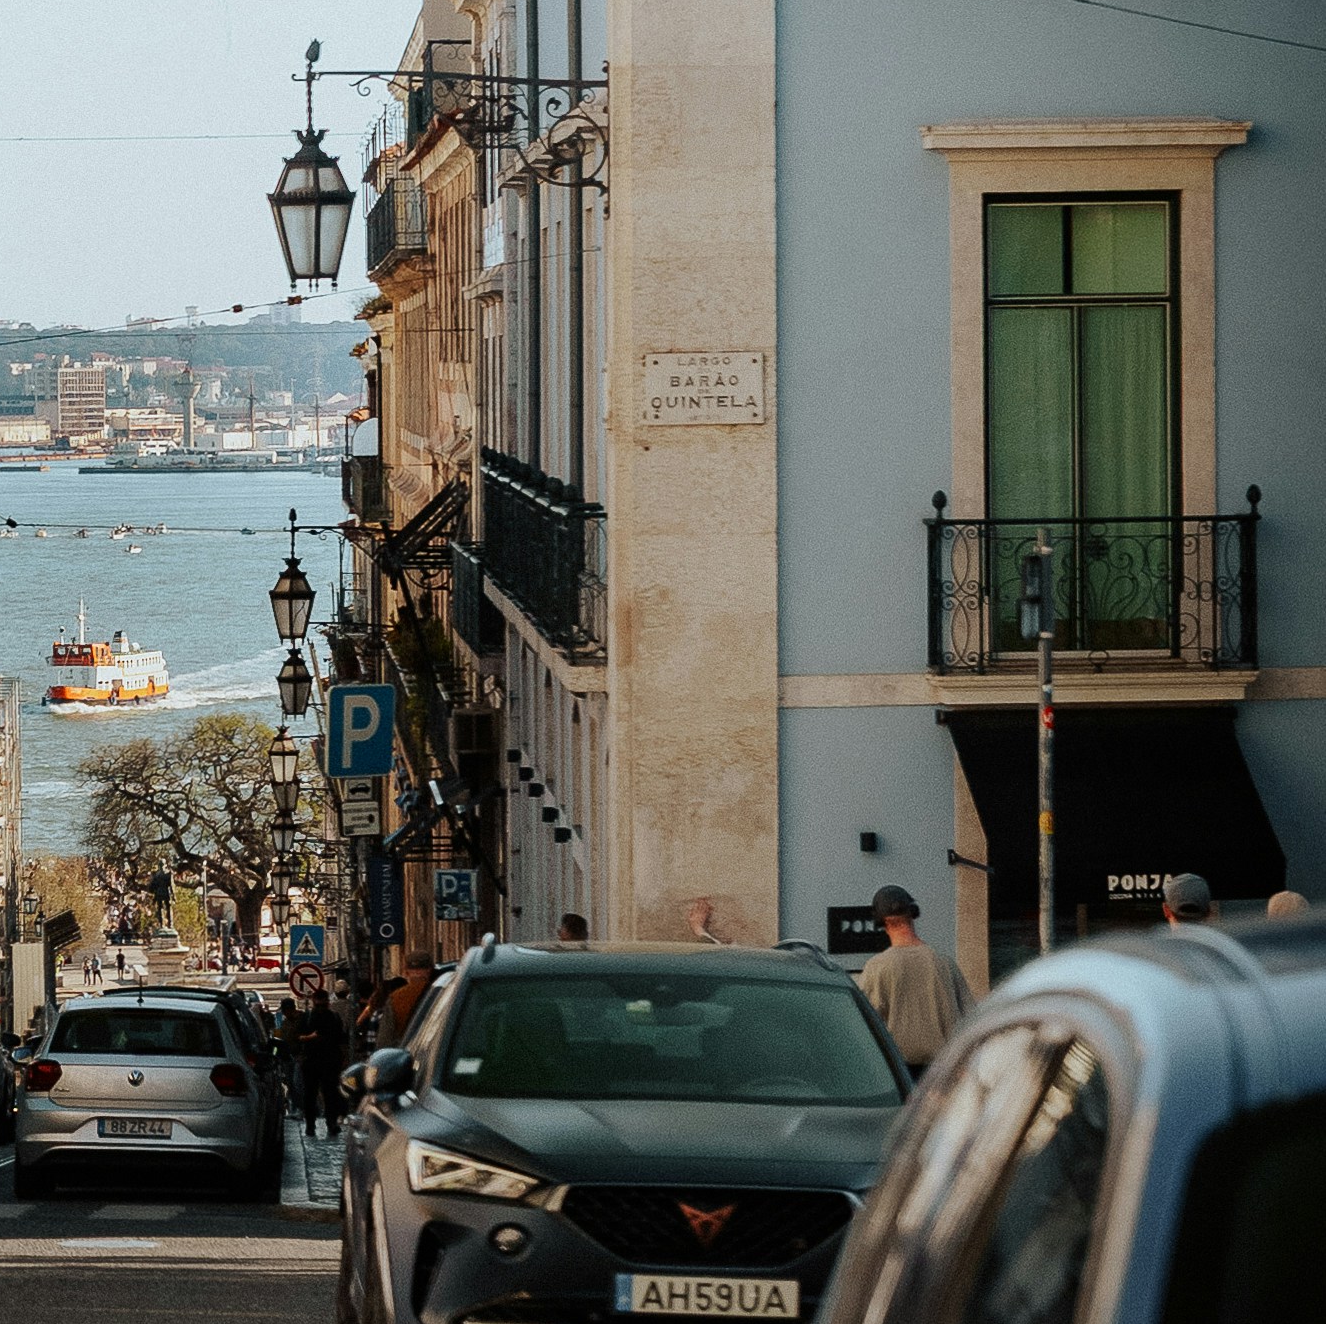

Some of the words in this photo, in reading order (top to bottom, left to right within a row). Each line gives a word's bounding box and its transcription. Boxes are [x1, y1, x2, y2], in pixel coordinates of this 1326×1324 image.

[677, 357, 731, 366] LARGO
[670, 372, 738, 387] BARÃO
[651, 396, 757, 413] QUINTELA
[342, 695, 380, 768] P
[441, 875, 457, 897] P
[641, 1281, 787, 1313] AH59UA
